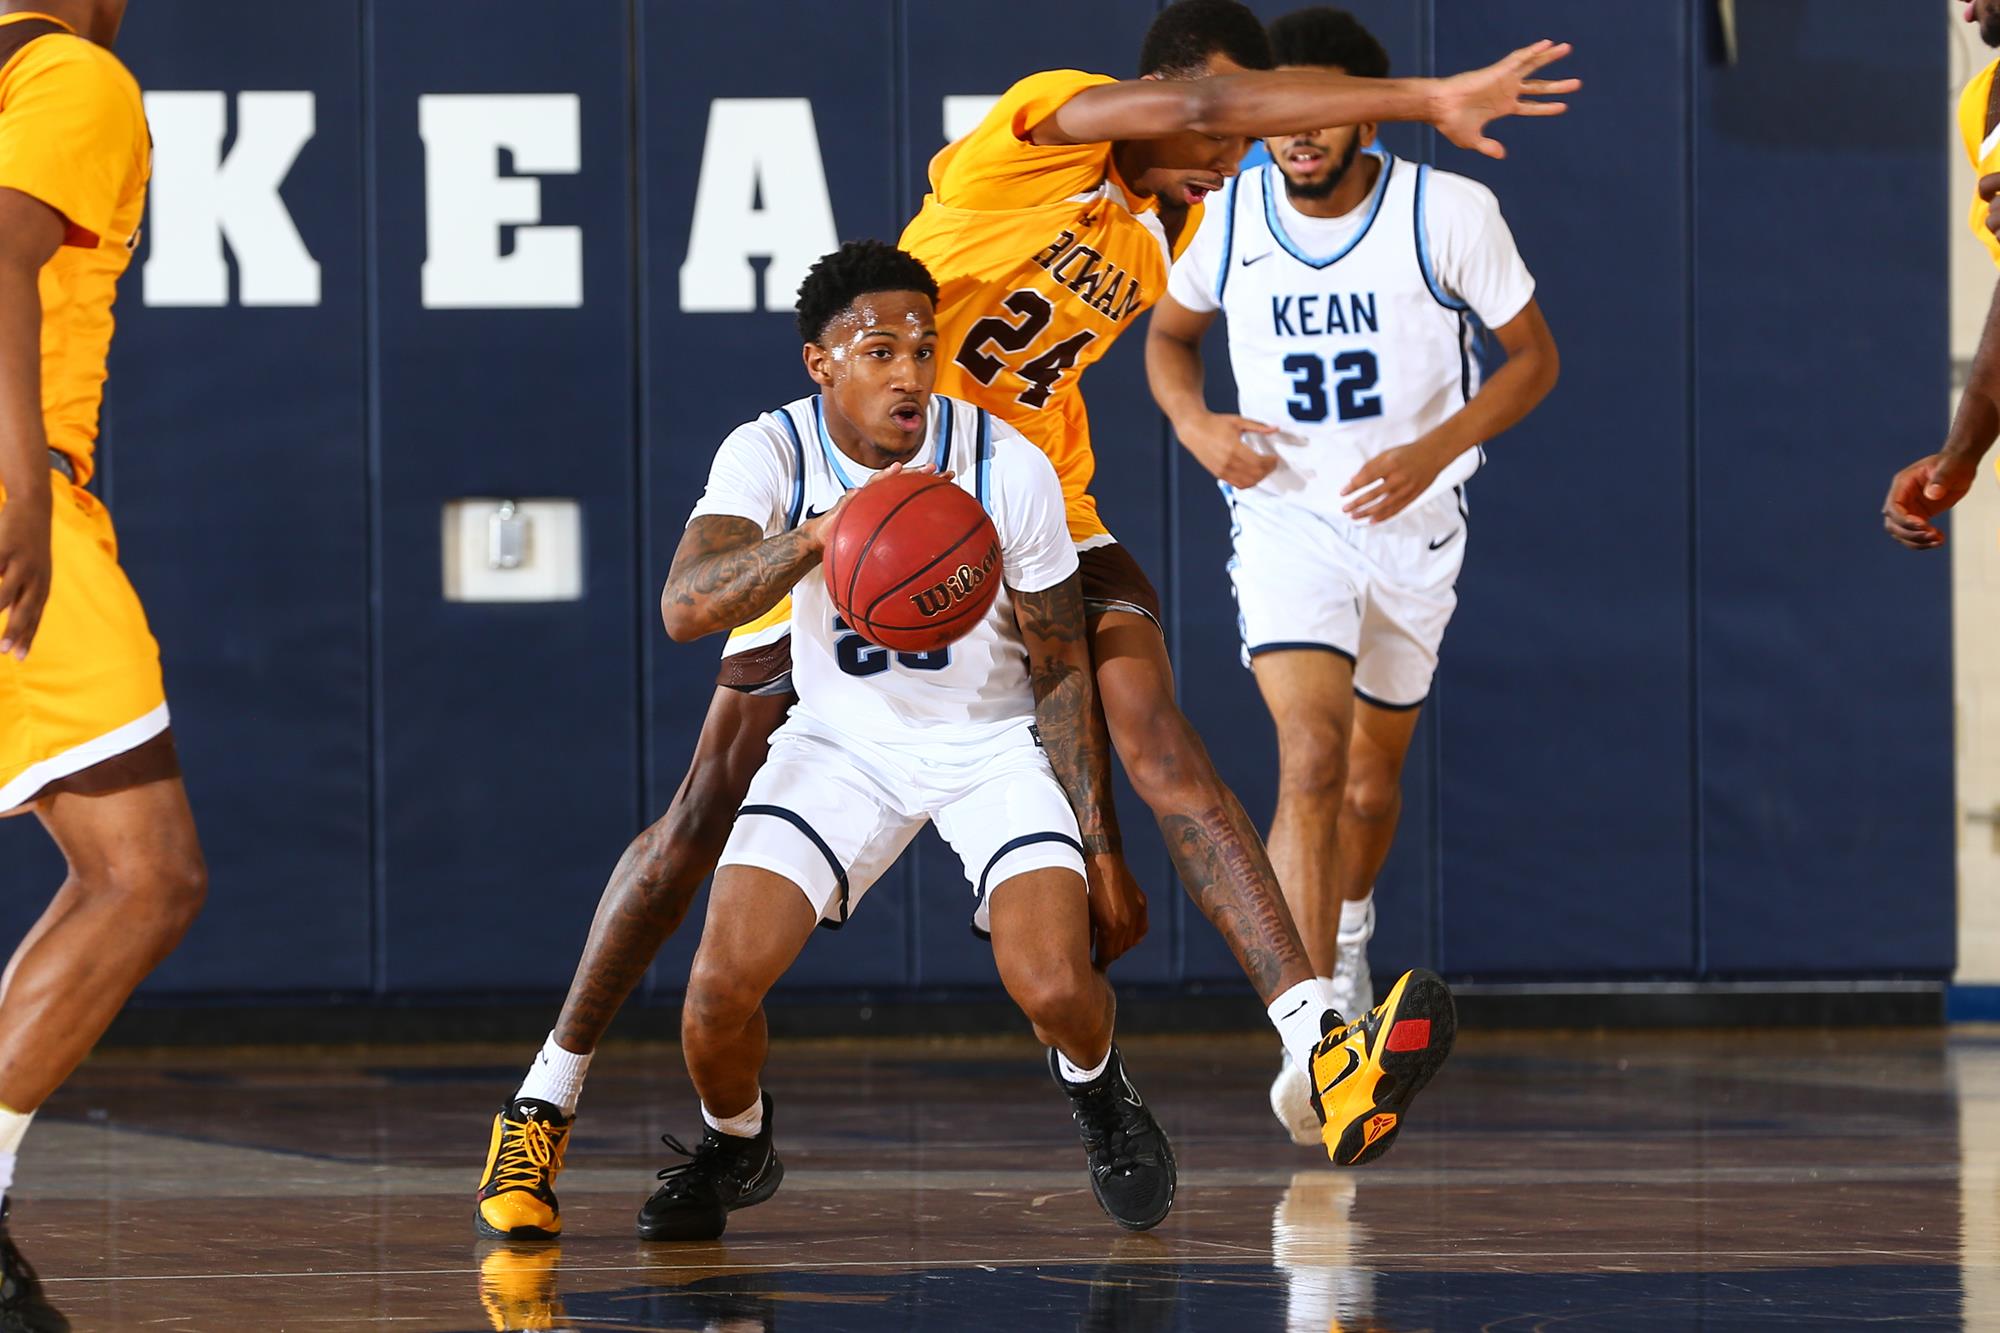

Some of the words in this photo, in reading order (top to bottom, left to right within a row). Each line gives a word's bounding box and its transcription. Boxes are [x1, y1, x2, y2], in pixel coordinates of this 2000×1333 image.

[142, 91, 1000, 313] KEA
[1031, 229, 1141, 323] ROWAN
[1272, 292, 1379, 337] KEAN
[952, 288, 1099, 410] 24
[1283, 349, 1382, 424] 32
[1202, 805, 1242, 848] THE
